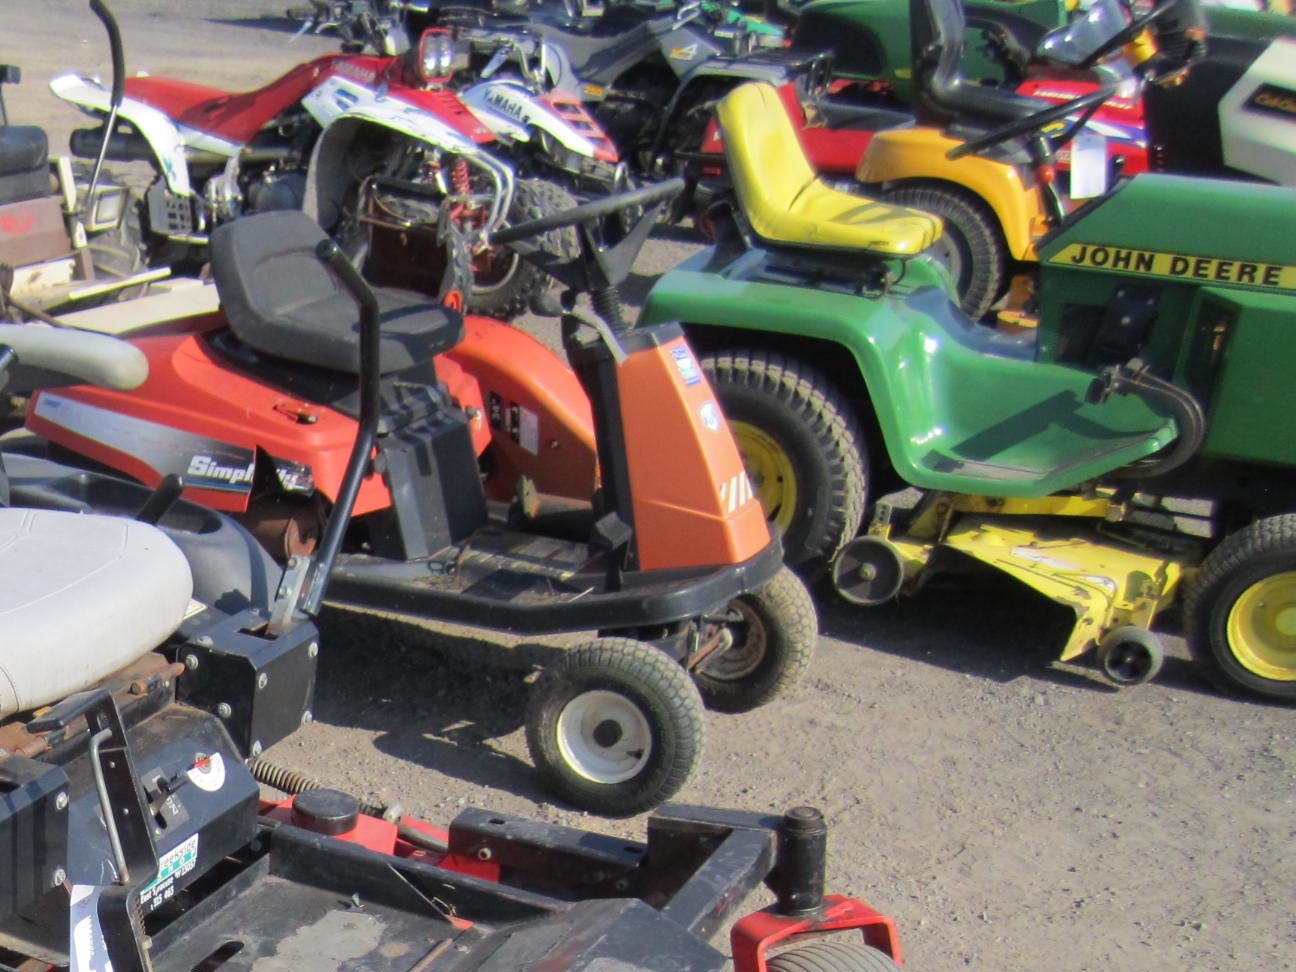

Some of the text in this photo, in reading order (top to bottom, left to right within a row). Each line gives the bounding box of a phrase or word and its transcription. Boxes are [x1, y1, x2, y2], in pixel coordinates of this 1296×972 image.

[483, 88, 523, 119] YAMAHA
[1071, 246, 1282, 286] JOHN DEERE
